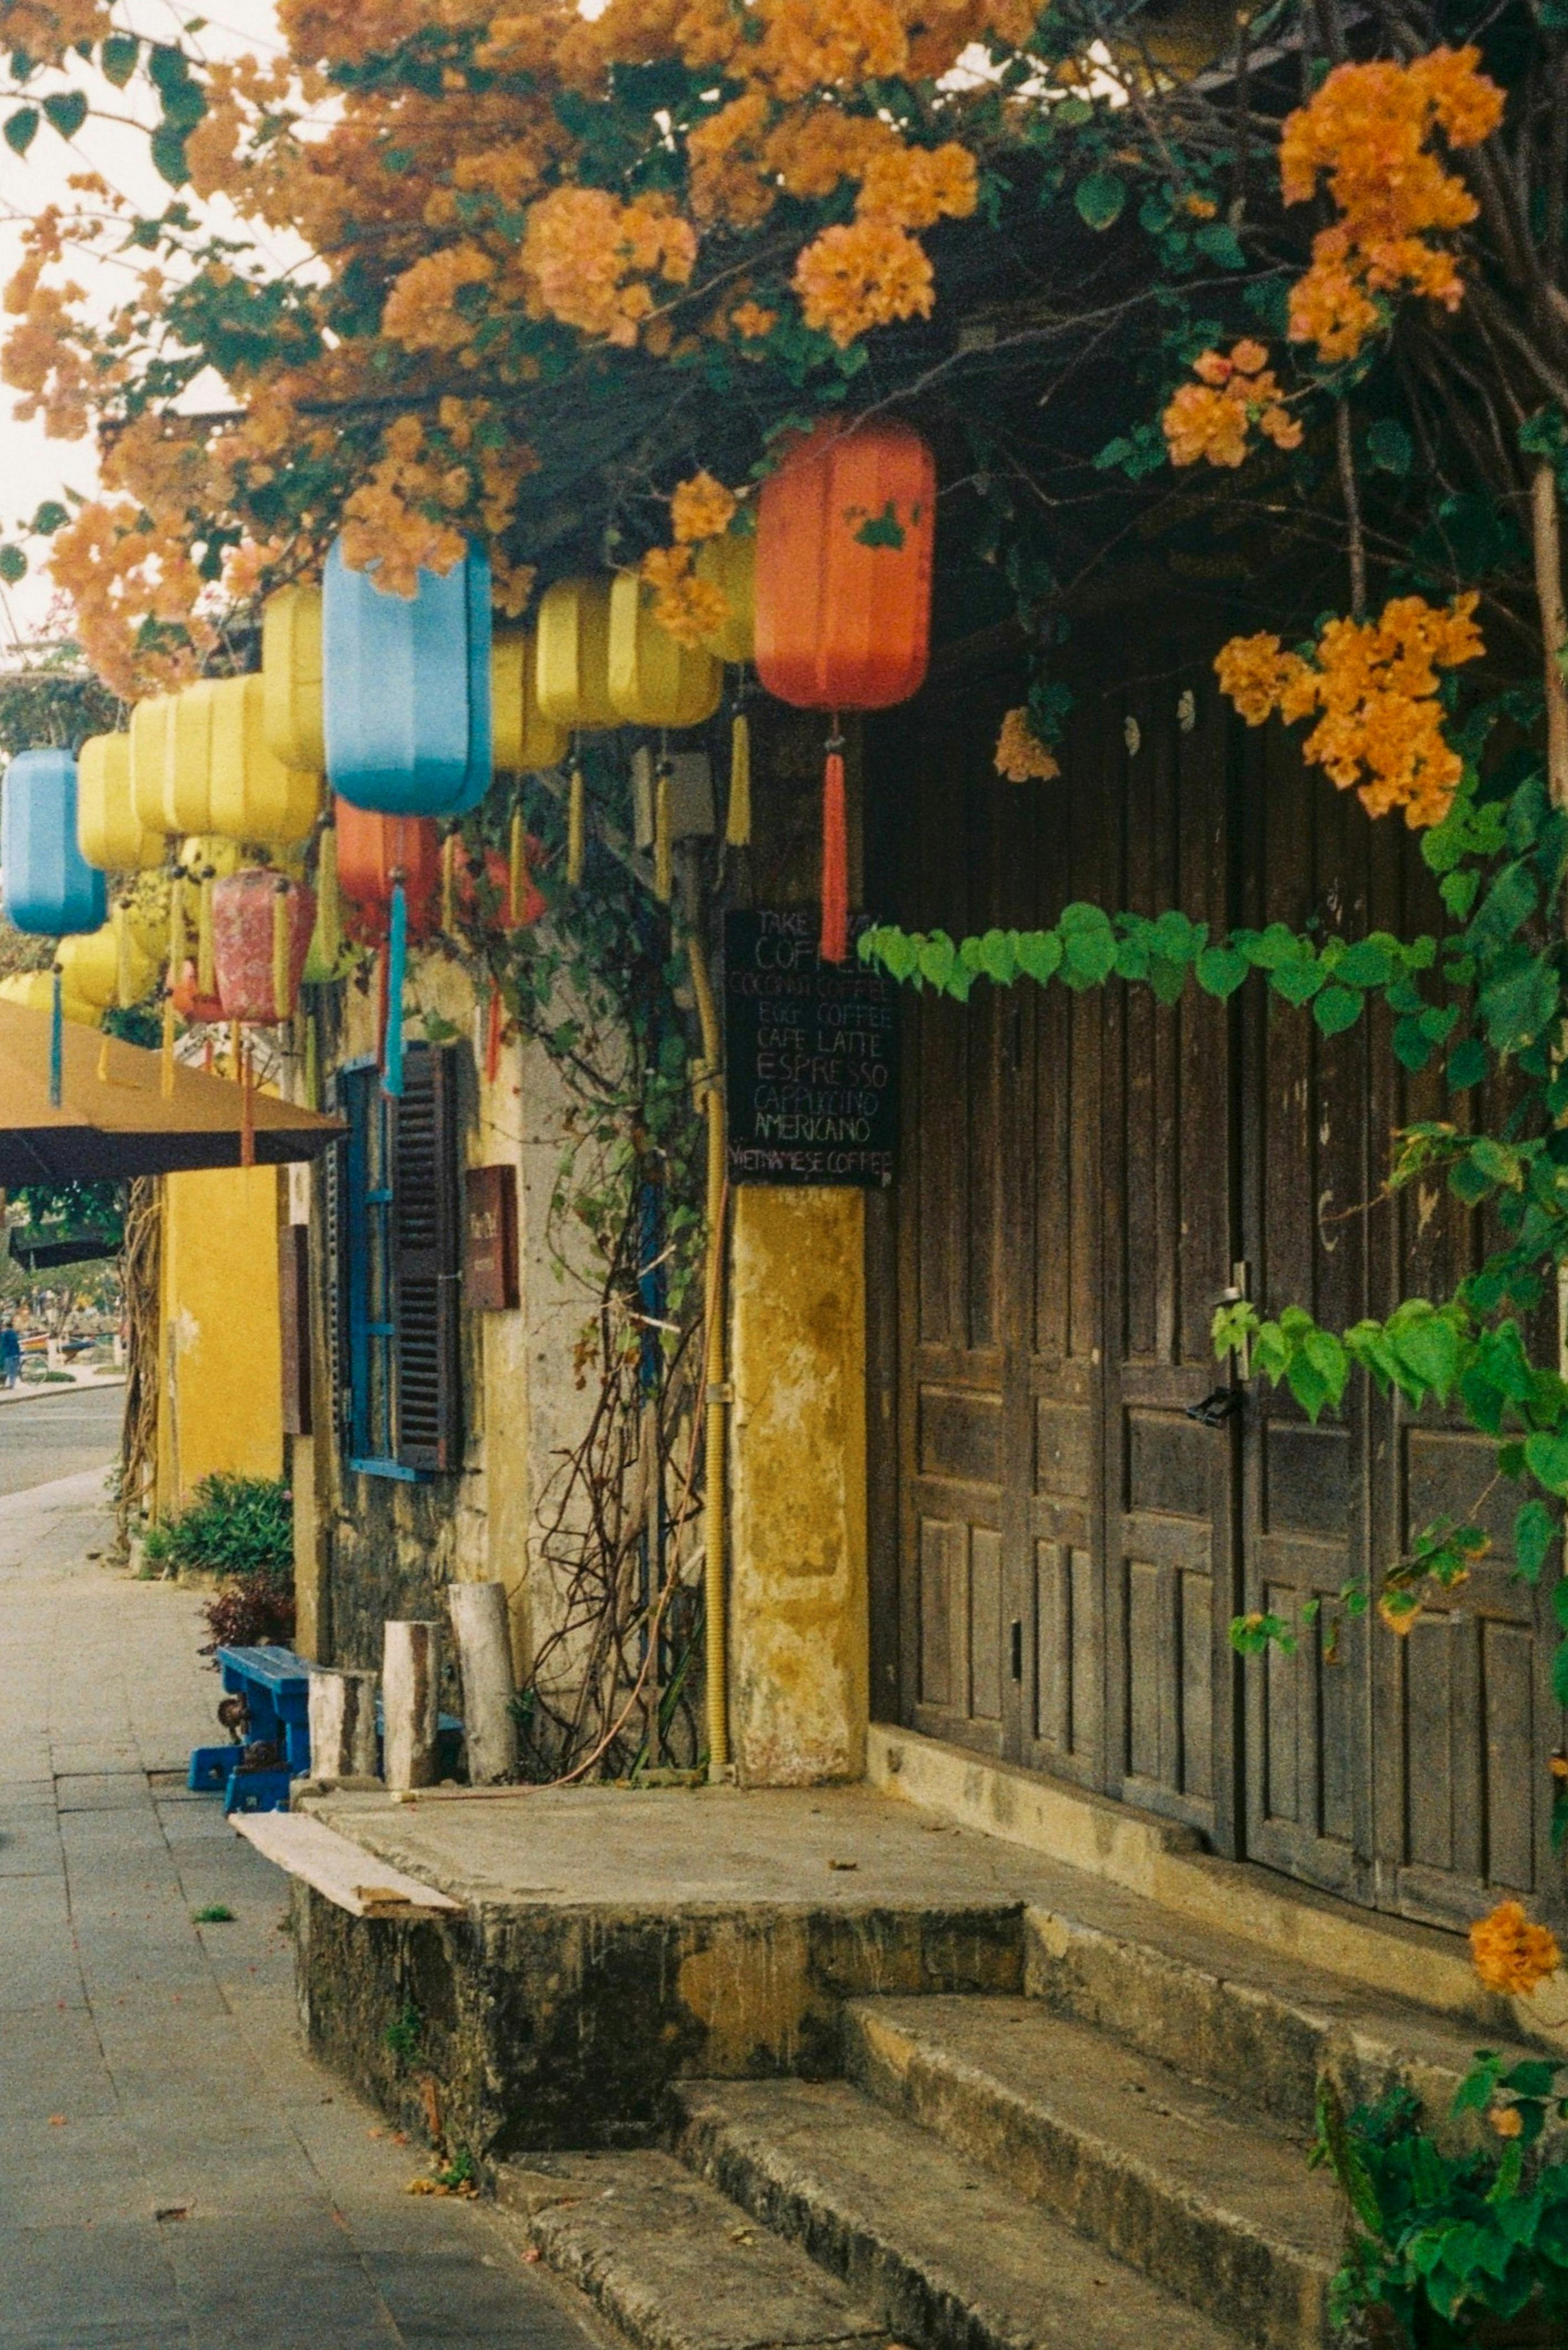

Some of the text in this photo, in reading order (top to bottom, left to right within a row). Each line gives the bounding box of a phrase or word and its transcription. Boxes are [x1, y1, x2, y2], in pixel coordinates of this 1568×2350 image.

[757, 910, 807, 937] TAKE
[817, 975, 890, 1002] COFFEE
[759, 1001, 891, 1029] EGG COFFEE
[758, 1028, 882, 1057] CAFE LATTE
[757, 1053, 888, 1089] ESPRESSO
[755, 1112, 871, 1142] AMERICANO
[728, 1145, 892, 1174] VIETNAMESE COFFEE
